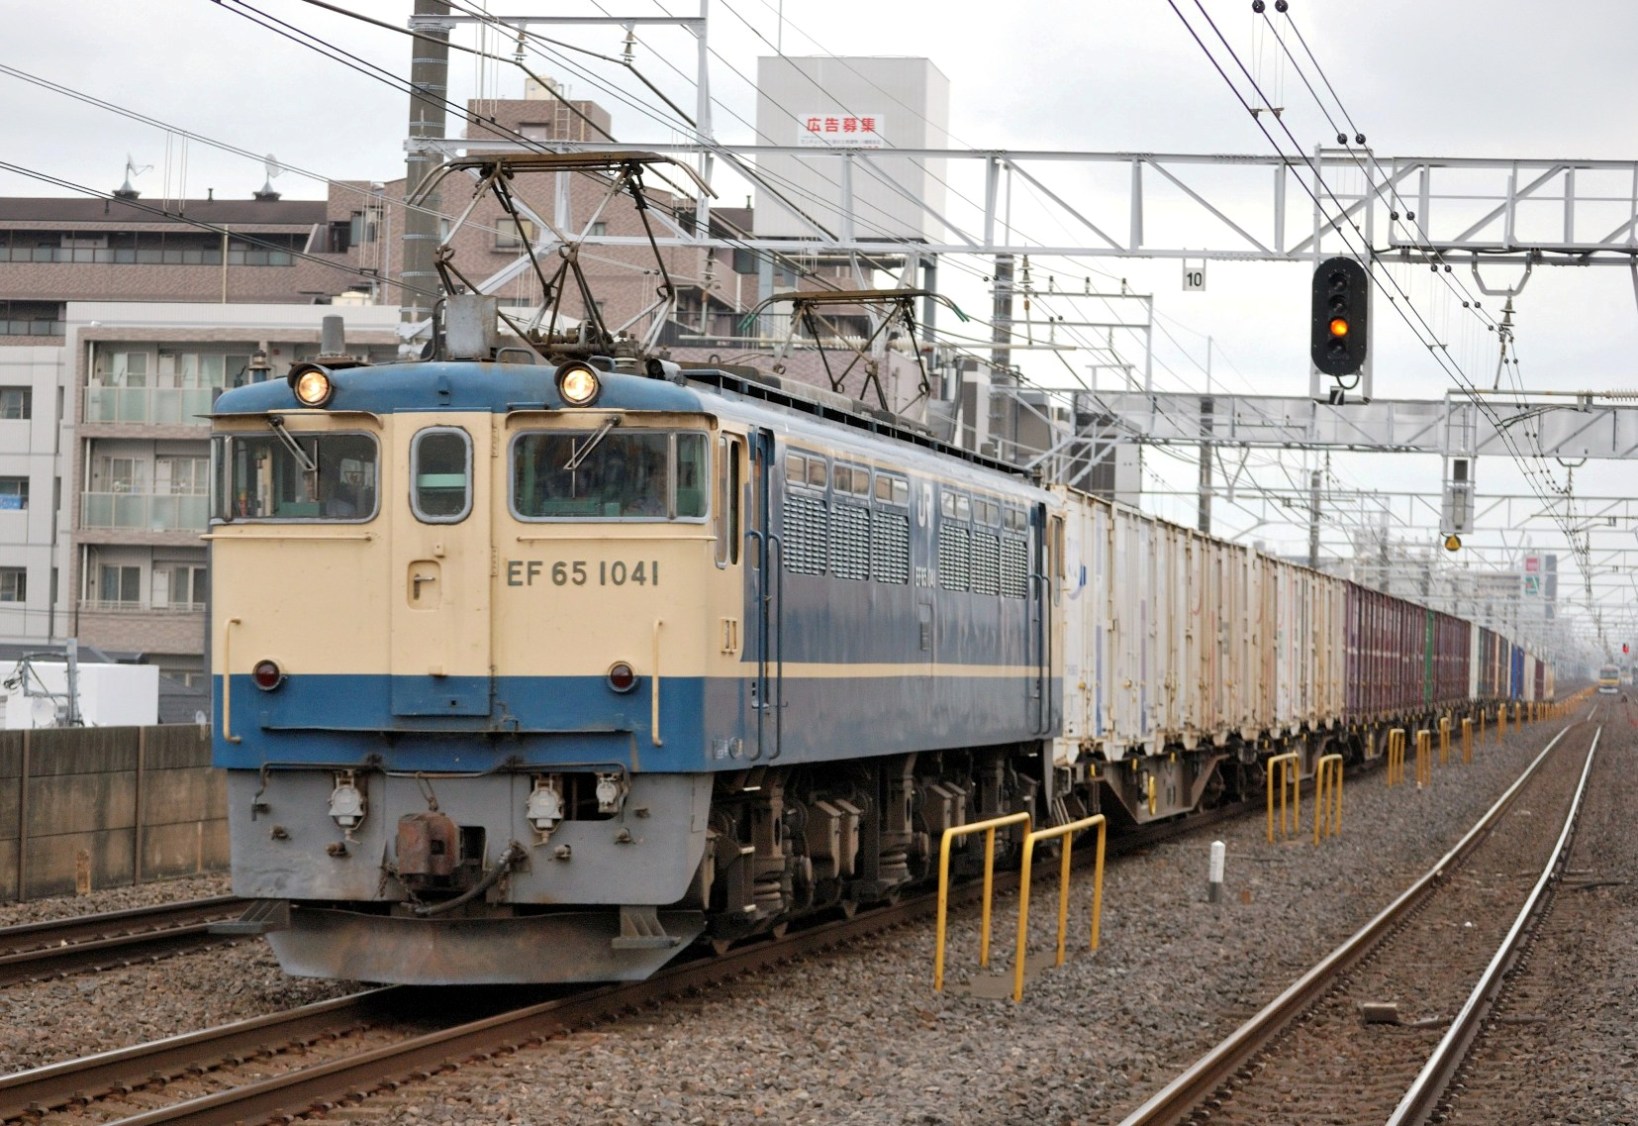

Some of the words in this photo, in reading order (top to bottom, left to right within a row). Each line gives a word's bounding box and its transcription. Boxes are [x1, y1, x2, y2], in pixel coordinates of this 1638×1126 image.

[807, 117, 875, 132] 広告募集
[1186, 271, 1202, 287] 10
[1331, 387, 1343, 405] 7
[918, 483, 934, 529] JR
[599, 560, 659, 586] 1041
